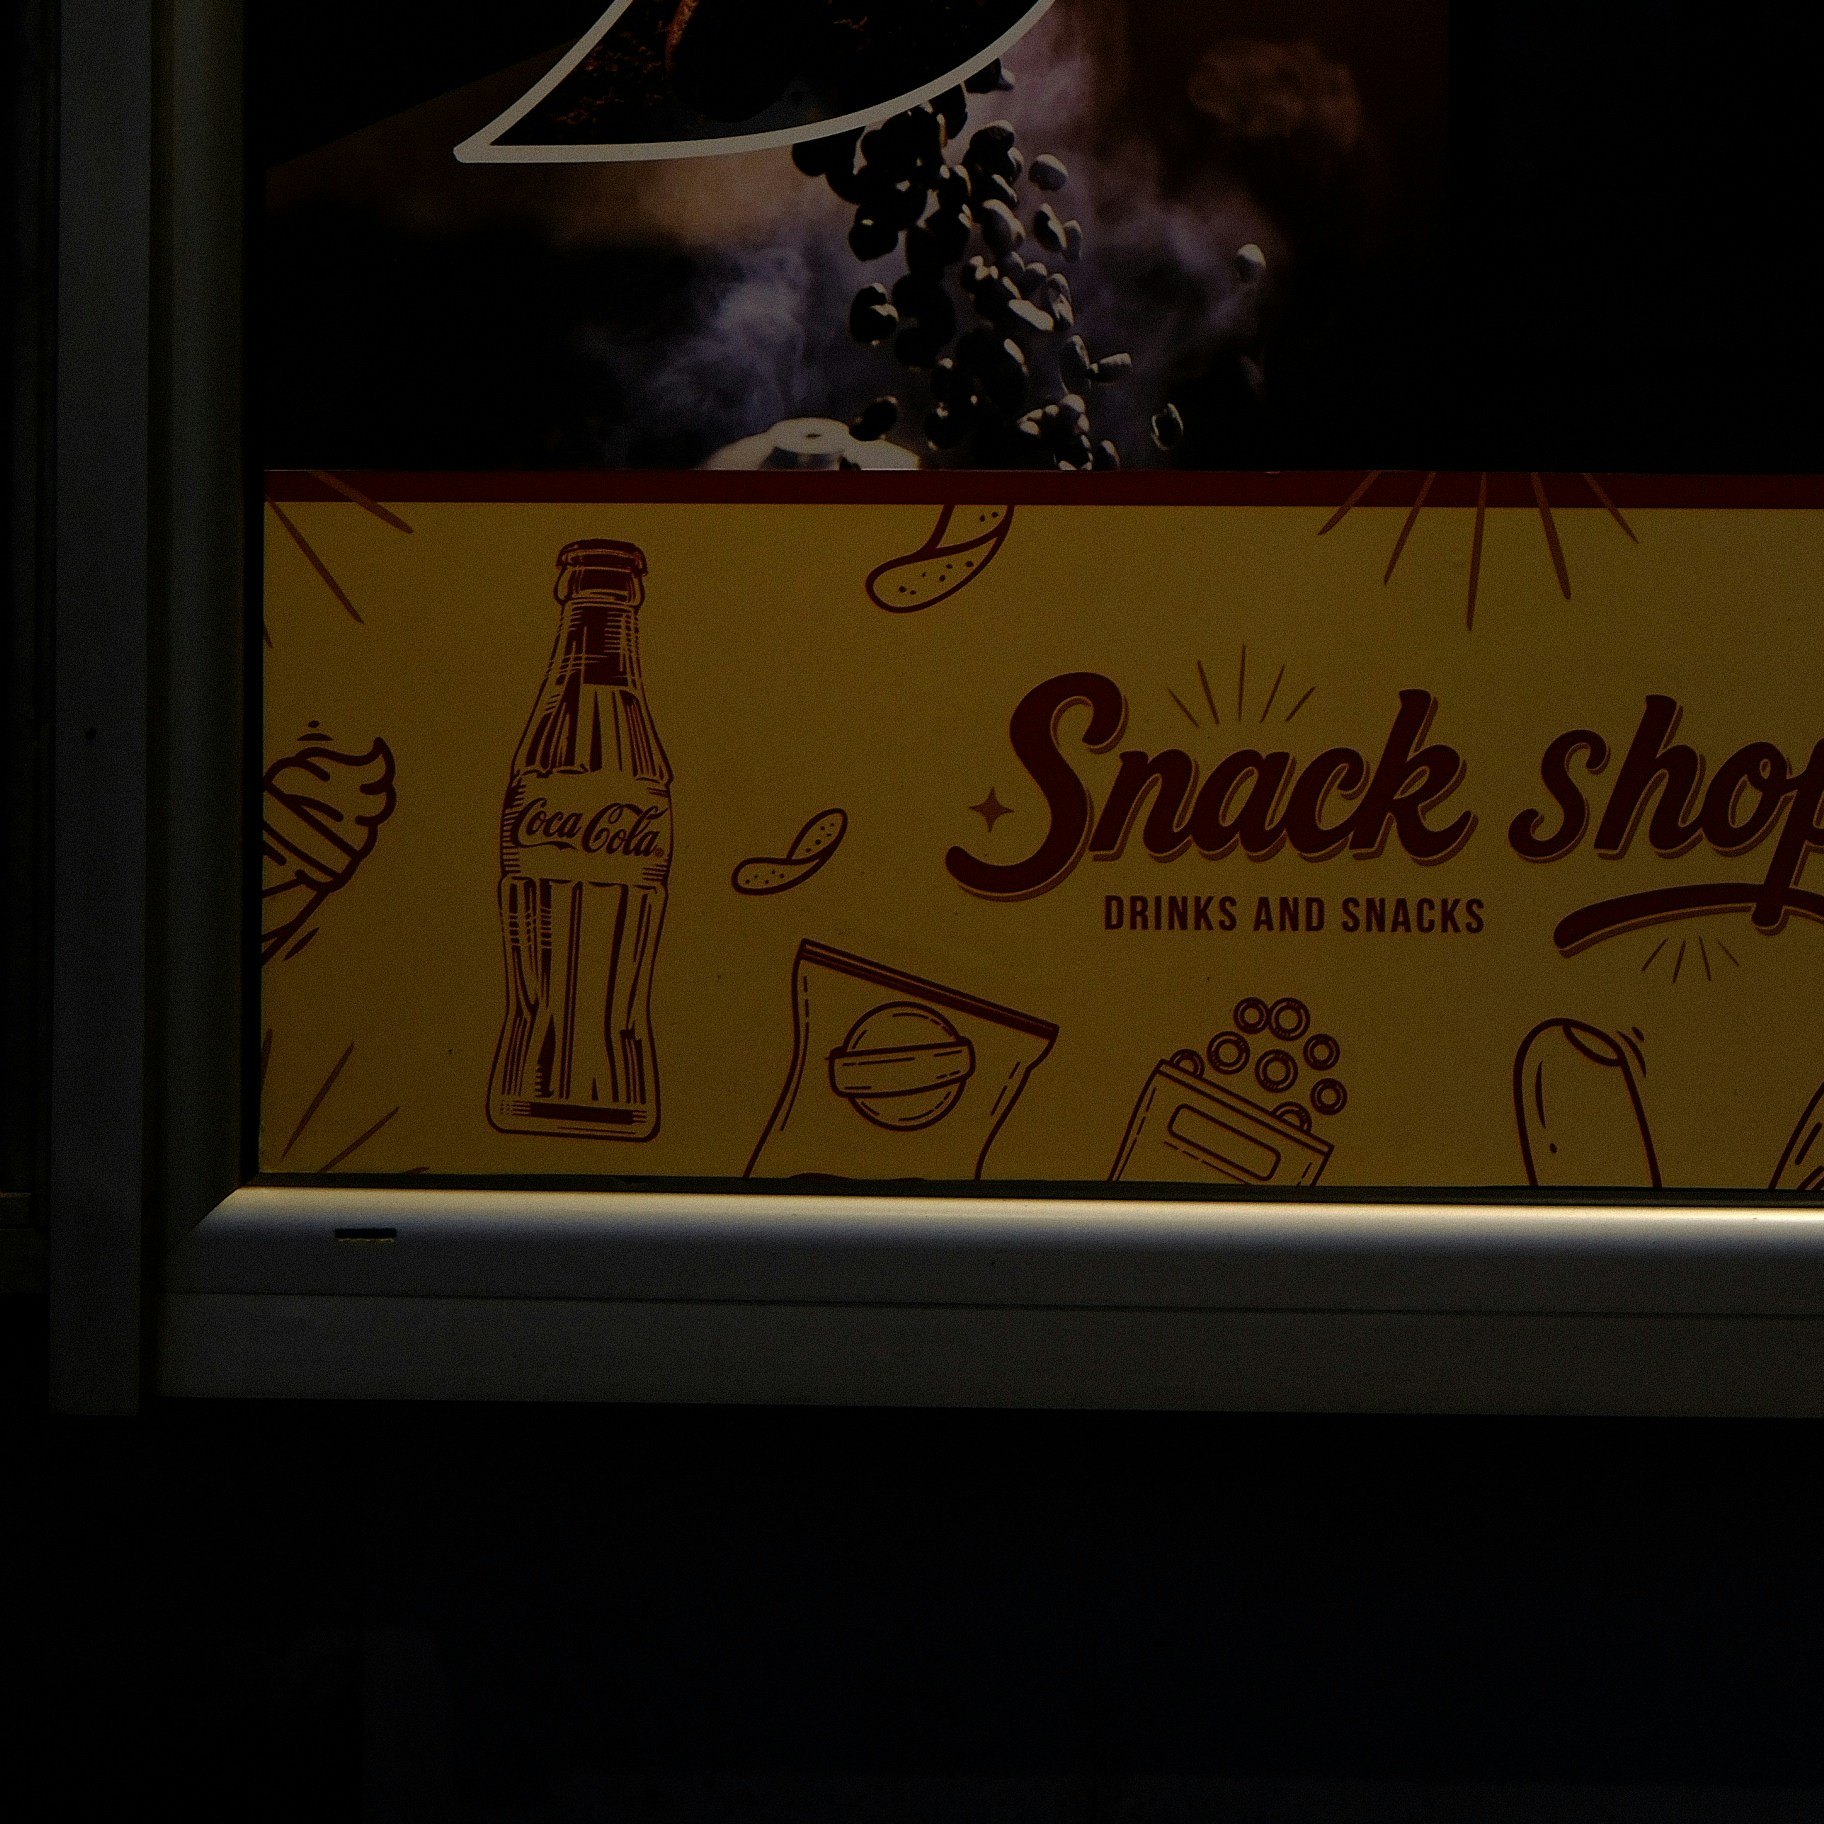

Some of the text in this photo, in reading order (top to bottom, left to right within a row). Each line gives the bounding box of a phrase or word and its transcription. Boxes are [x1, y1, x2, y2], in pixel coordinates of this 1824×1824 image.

[944, 670, 1478, 903] Snack
[1103, 894, 1486, 935] DRINKS AND SNACKS
